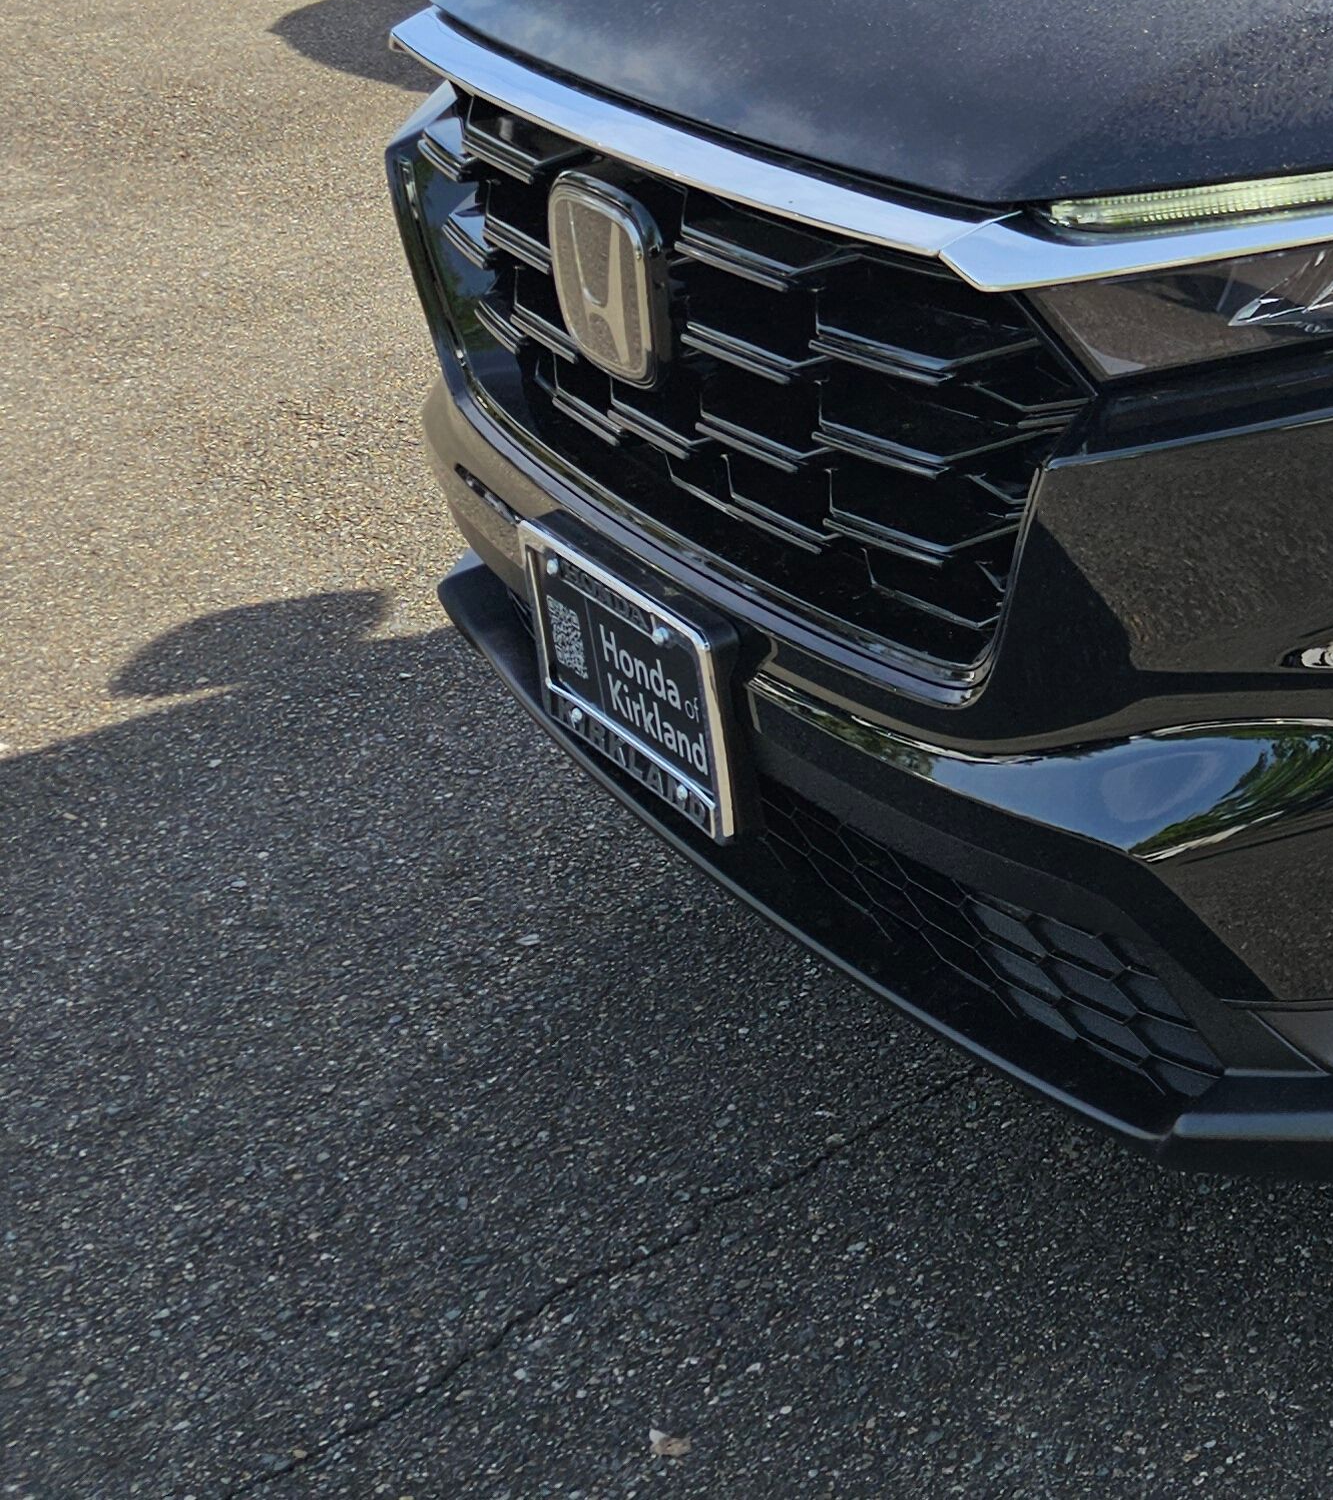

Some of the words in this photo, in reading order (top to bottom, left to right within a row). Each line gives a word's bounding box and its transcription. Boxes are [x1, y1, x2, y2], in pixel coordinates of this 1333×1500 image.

[600, 624, 681, 710] Honda
[684, 697, 700, 723] of
[607, 672, 708, 776] Kirkland
